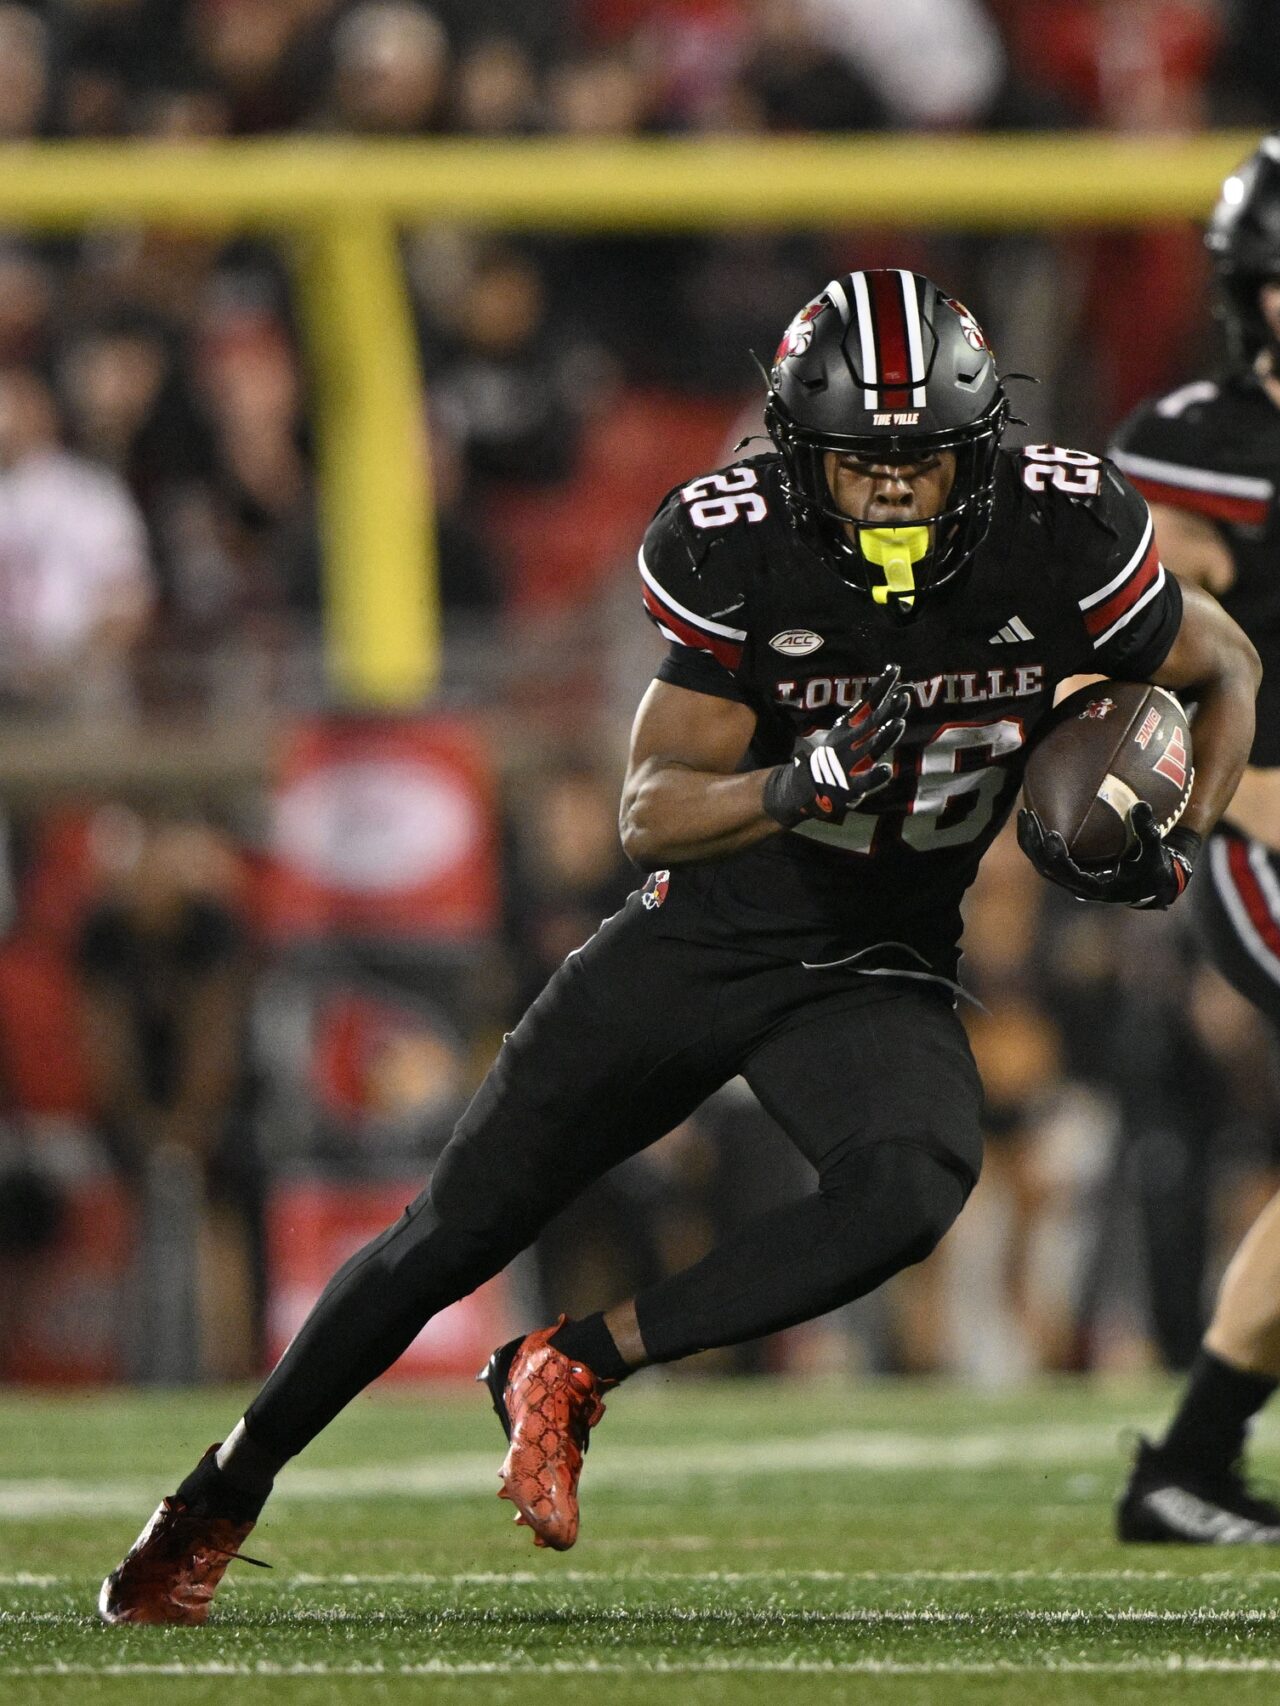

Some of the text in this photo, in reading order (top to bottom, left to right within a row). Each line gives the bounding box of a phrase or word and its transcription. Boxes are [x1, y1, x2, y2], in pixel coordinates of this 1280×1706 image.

[873, 412, 919, 426] THE VILLE
[1023, 444, 1102, 495] 26
[682, 466, 768, 529] 26
[780, 635, 814, 646] ACC
[775, 665, 1043, 709] LOUVILLE
[1134, 707, 1161, 750] DIME
